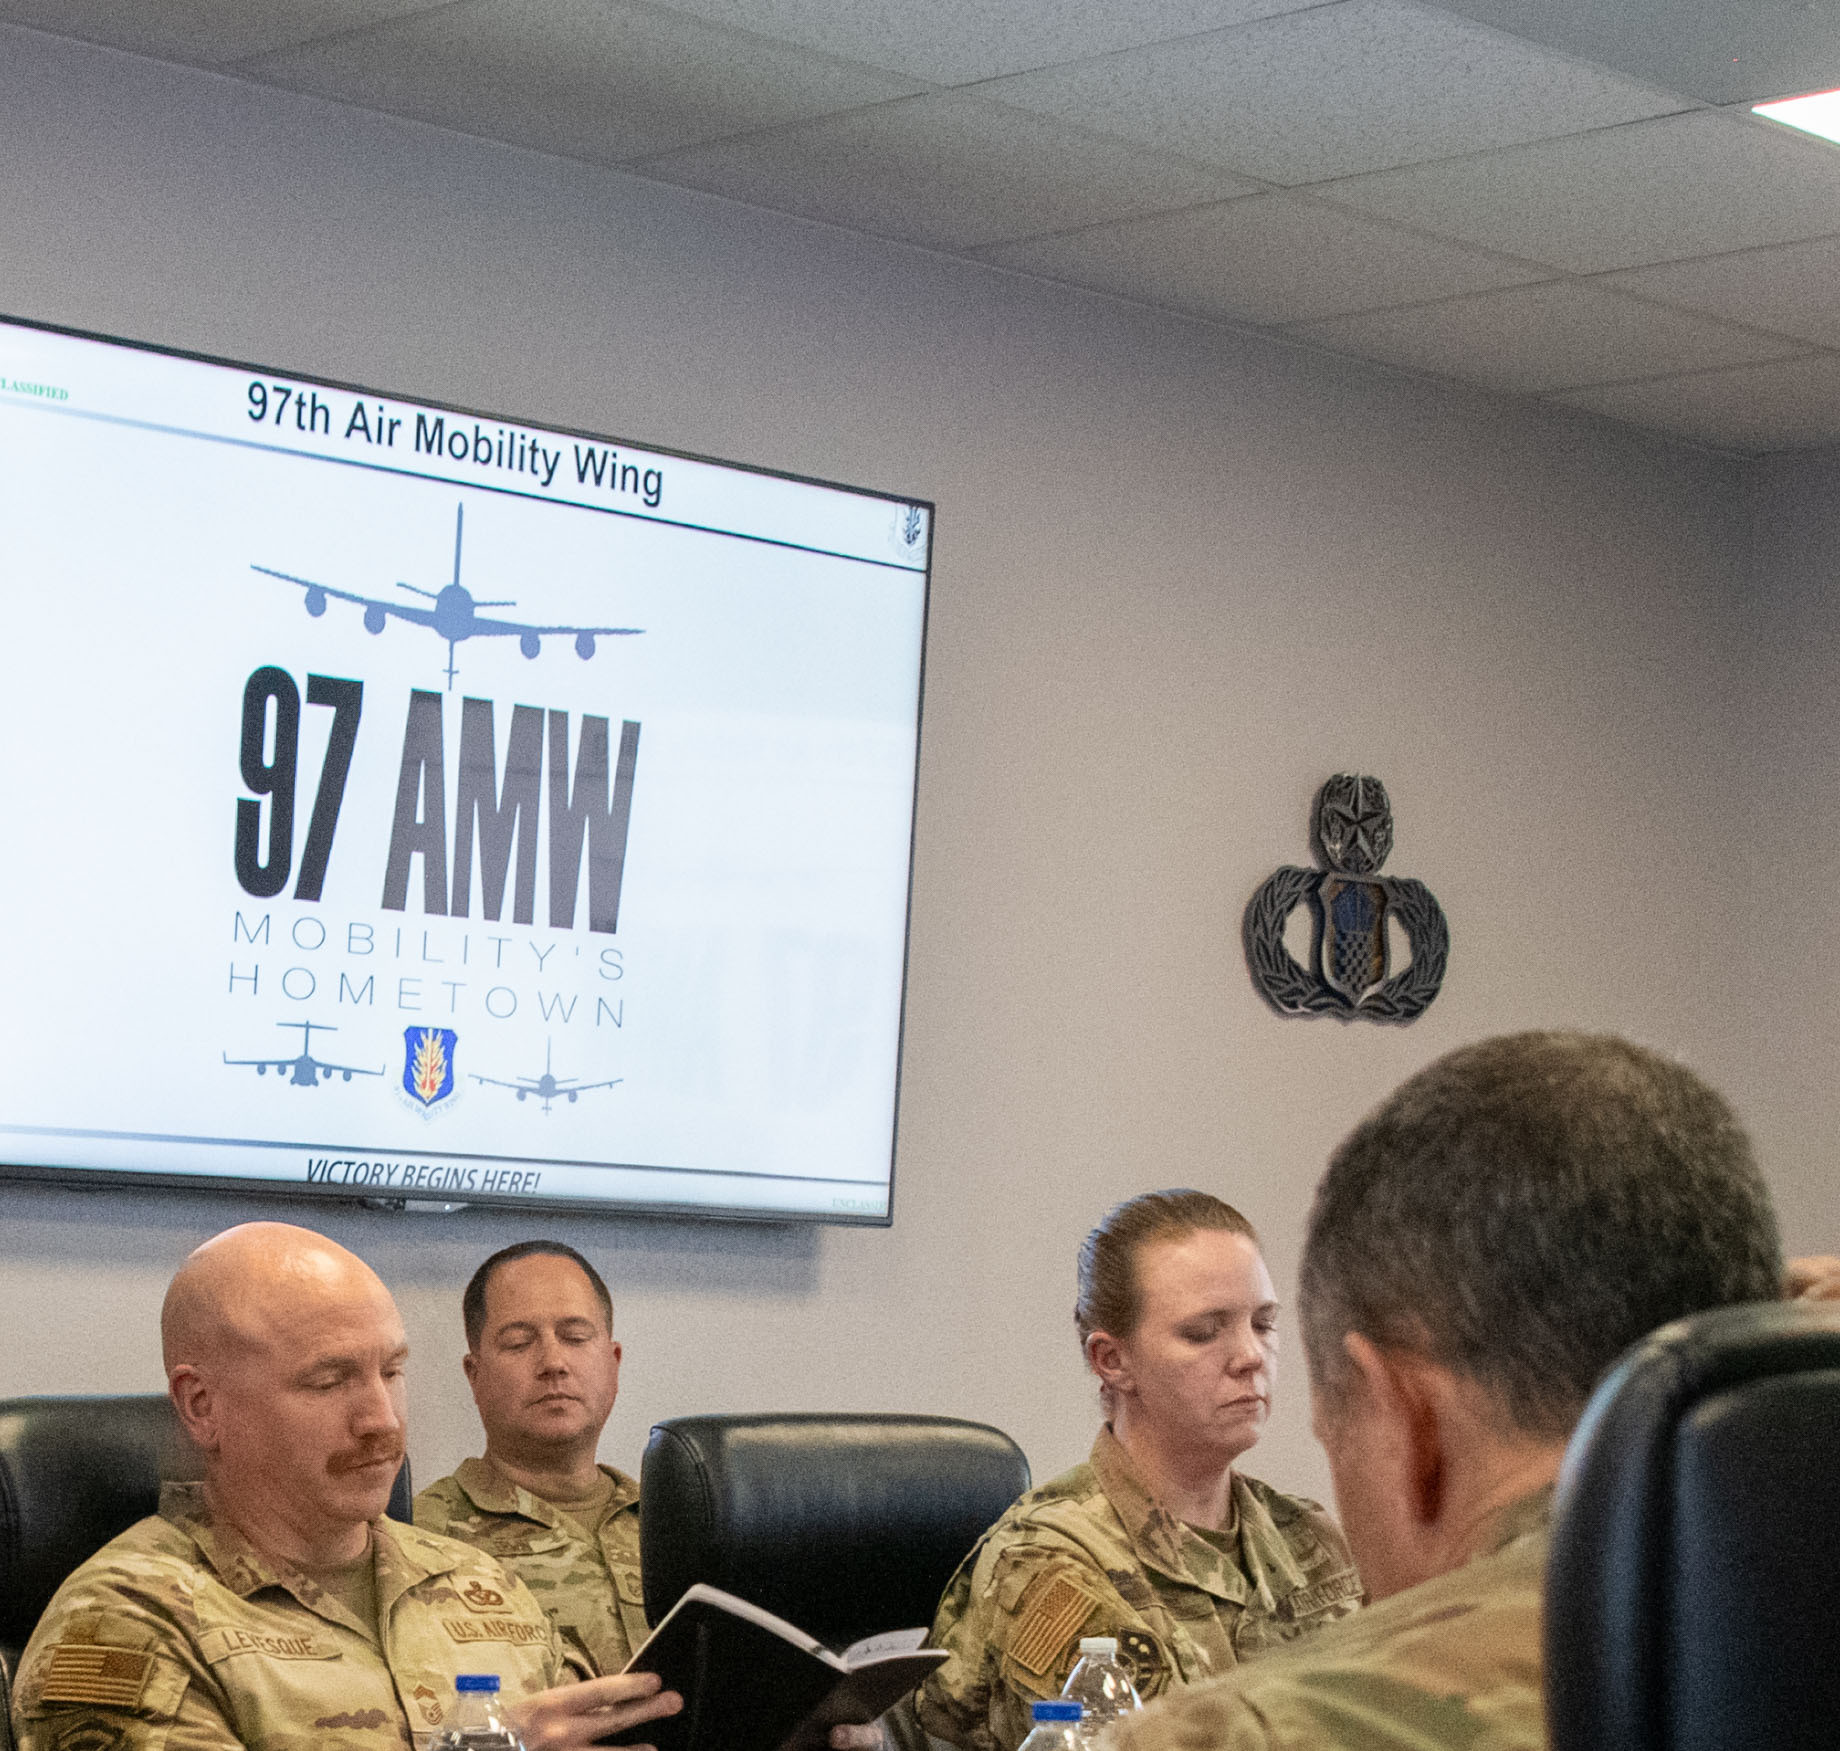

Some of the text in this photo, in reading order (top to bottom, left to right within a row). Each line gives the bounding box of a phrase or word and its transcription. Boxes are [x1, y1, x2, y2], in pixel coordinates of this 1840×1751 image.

[247, 381, 663, 507] 97th Air Mobility Wing
[234, 664, 642, 935] 97 AMW
[234, 911, 624, 981] MOBILITY'S
[229, 961, 623, 1028] HOMETOWN
[307, 1159, 542, 1194] VICTORY BEGINS HERE!
[221, 1630, 318, 1656] LEVESQUE
[486, 1620, 510, 1641] AIR
[510, 1622, 547, 1642] FORC
